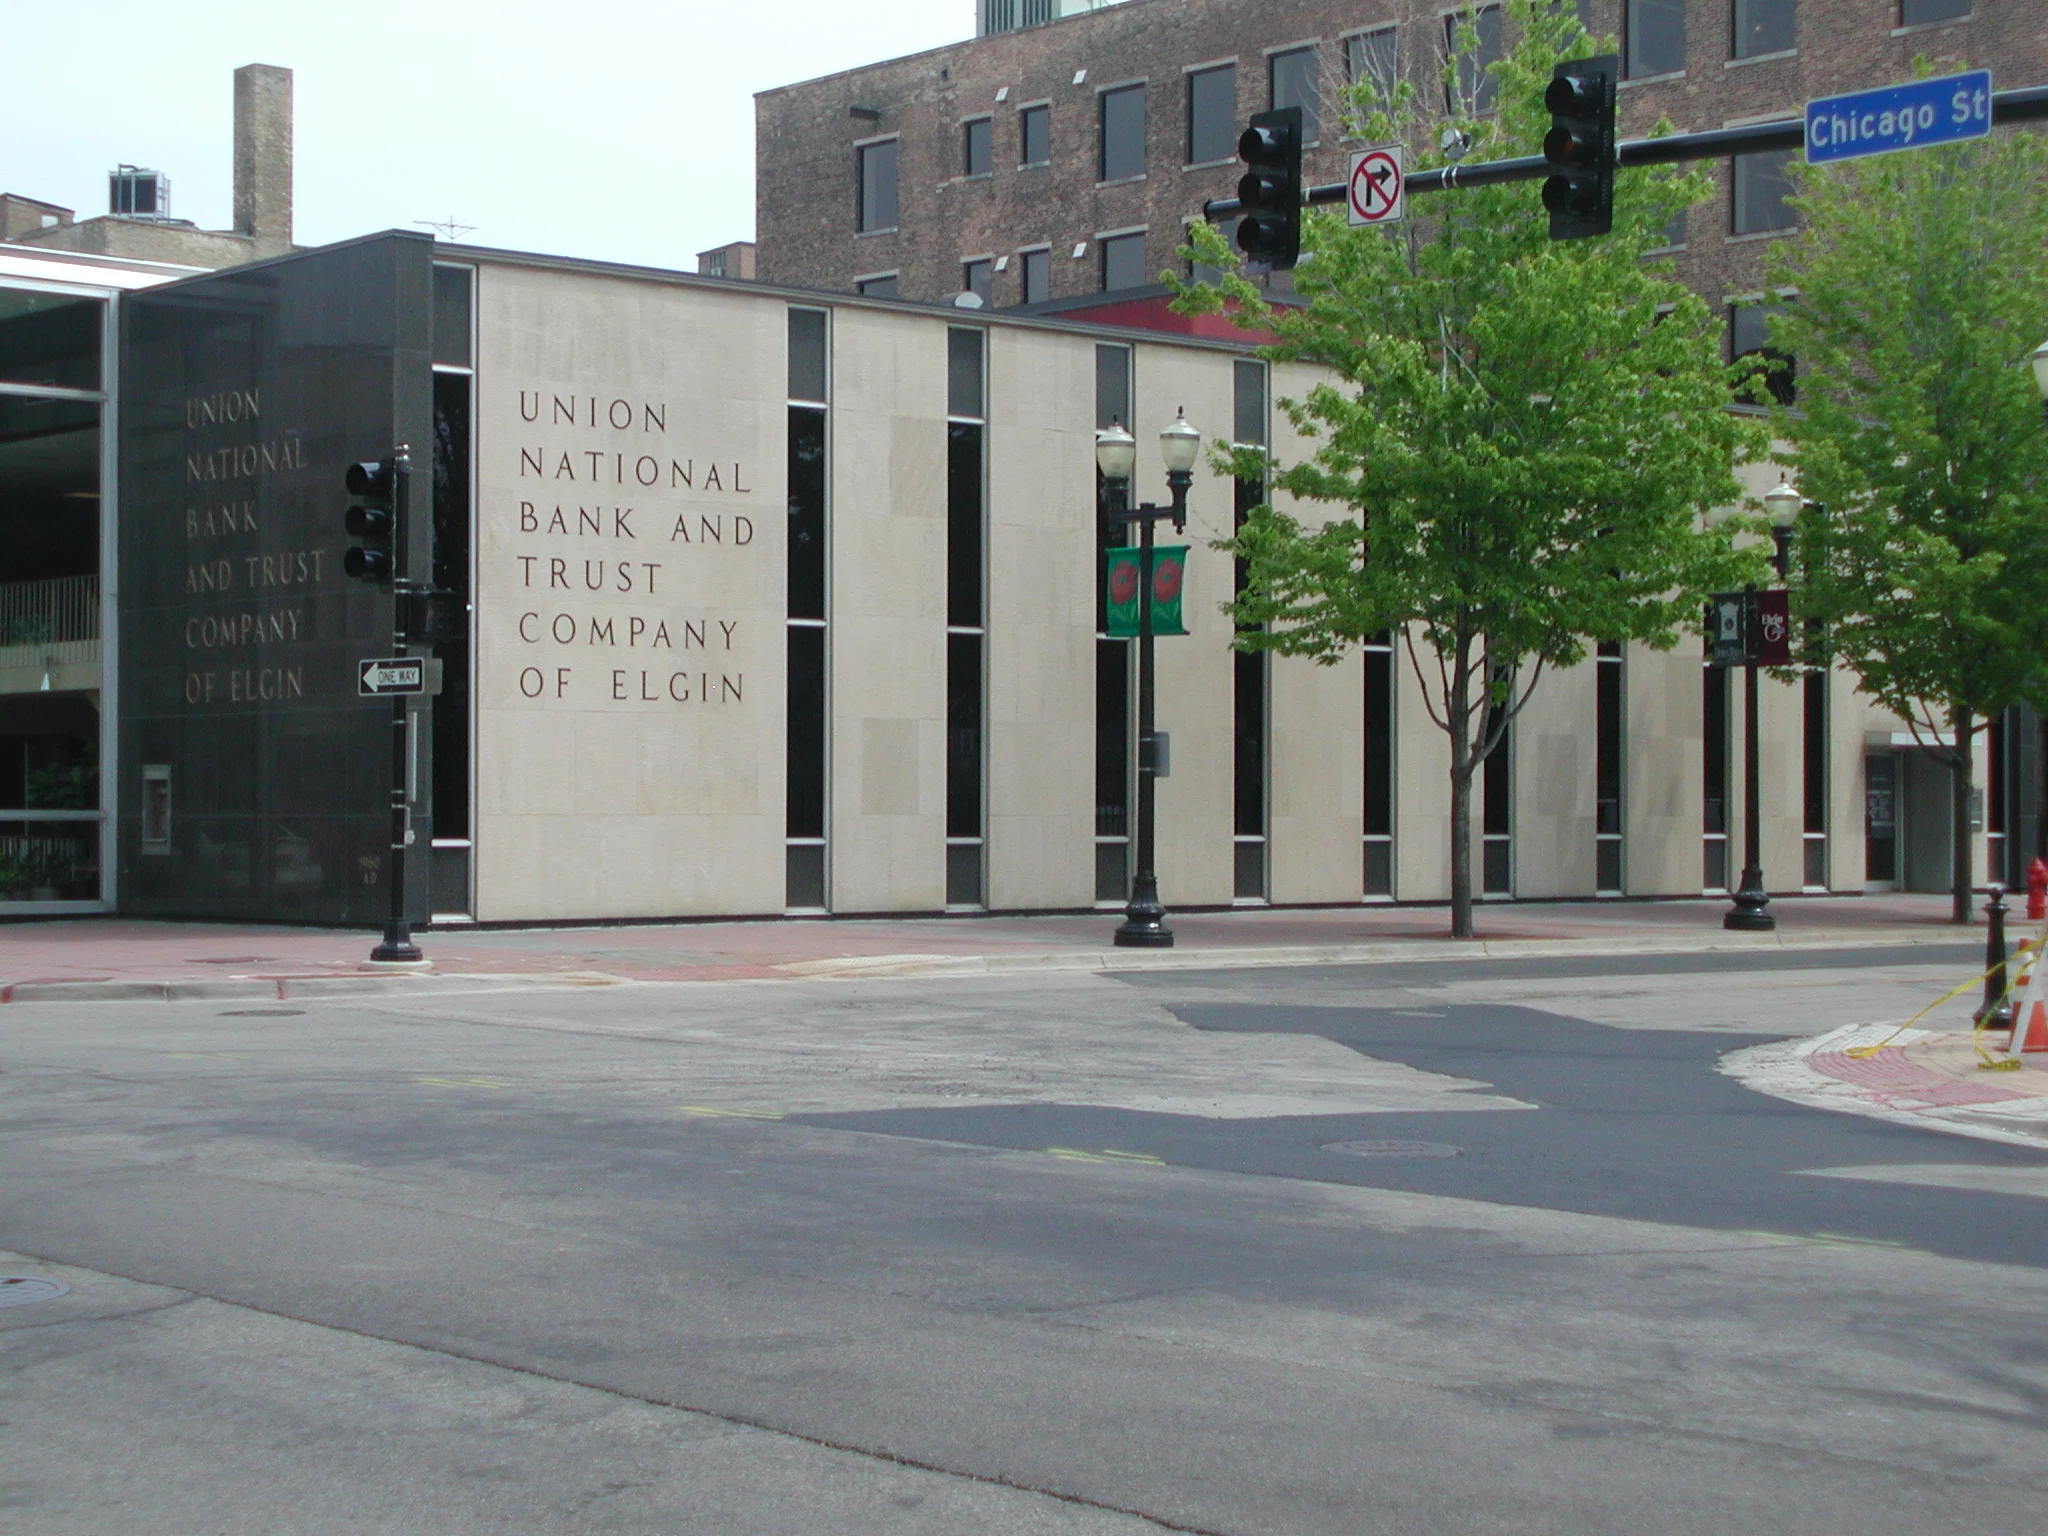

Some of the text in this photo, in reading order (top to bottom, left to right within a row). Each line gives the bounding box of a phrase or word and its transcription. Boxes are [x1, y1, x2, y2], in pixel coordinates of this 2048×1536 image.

[1810, 88, 1985, 147] Chicago St
[187, 387, 260, 428] UNION
[520, 390, 666, 433] UNION
[187, 437, 307, 482] NATIONAL
[520, 447, 751, 493] NATIONAL
[186, 501, 258, 539] BANK
[519, 501, 754, 546] BANK AND
[185, 550, 325, 594] AND TRUST
[517, 555, 662, 594] TRUST
[185, 609, 302, 649] COMPANY
[519, 612, 738, 650] COMPANY
[185, 668, 302, 704] OF ELGIN
[378, 669, 417, 684] ONE WAY
[520, 666, 743, 703] OF ELGIN
